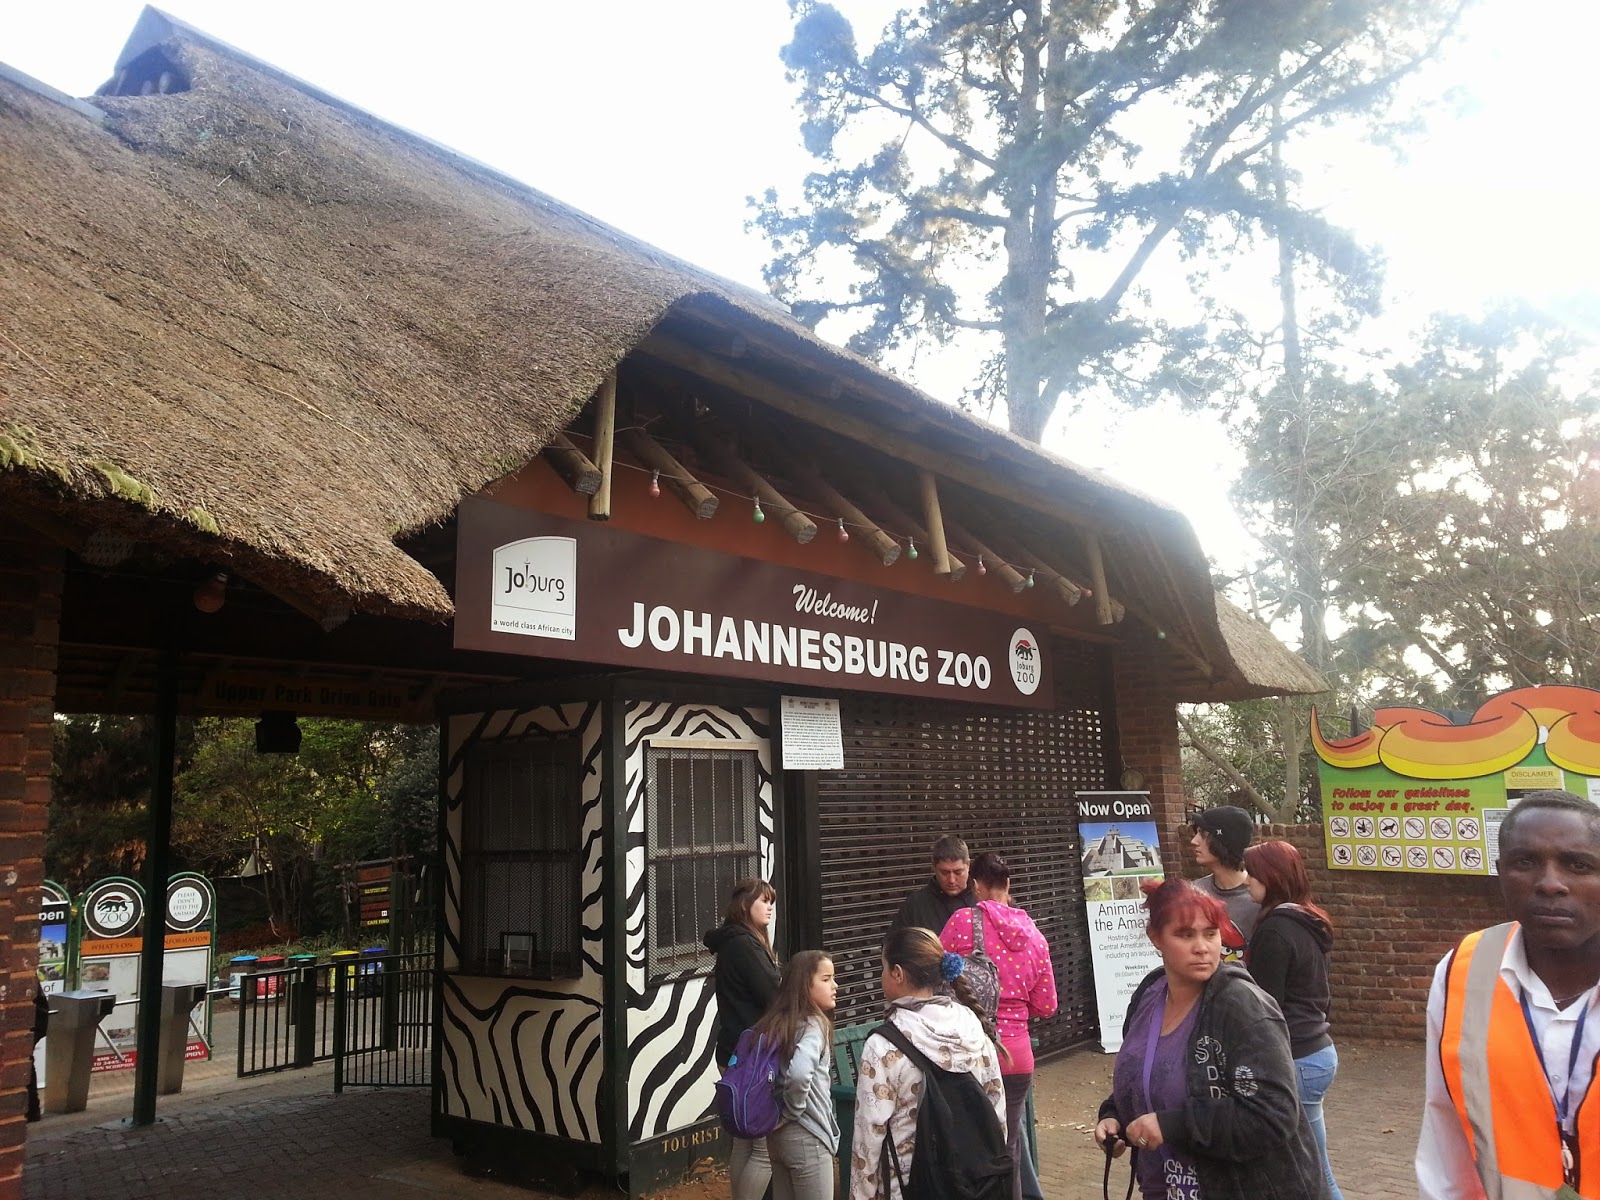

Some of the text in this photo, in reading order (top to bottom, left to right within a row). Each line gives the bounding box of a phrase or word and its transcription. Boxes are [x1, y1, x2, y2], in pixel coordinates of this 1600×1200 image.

[505, 560, 565, 601] Joburg
[793, 584, 878, 624] Welcome!
[500, 619, 519, 628] world
[521, 621, 536, 630] class
[537, 624, 560, 633] African
[561, 627, 573, 635] city
[618, 602, 992, 689] JOHANNESBURG ZOO
[1016, 660, 1035, 673] Joburg
[1016, 671, 1035, 684] ZOO
[274, 682, 312, 703] Park
[1332, 787, 1470, 800] Follow our guidelines
[1079, 800, 1150, 818] Now Open
[1331, 800, 1475, 813] to enjoy a great day.
[38, 910, 65, 921] pen
[100, 911, 131, 923] ZOO
[1095, 916, 1150, 932] the Ama
[166, 935, 208, 944] NFORMATION
[1098, 943, 1119, 951] Central
[1105, 951, 1130, 959] including
[43, 982, 56, 993] of
[661, 1126, 720, 1154] TOURIST
